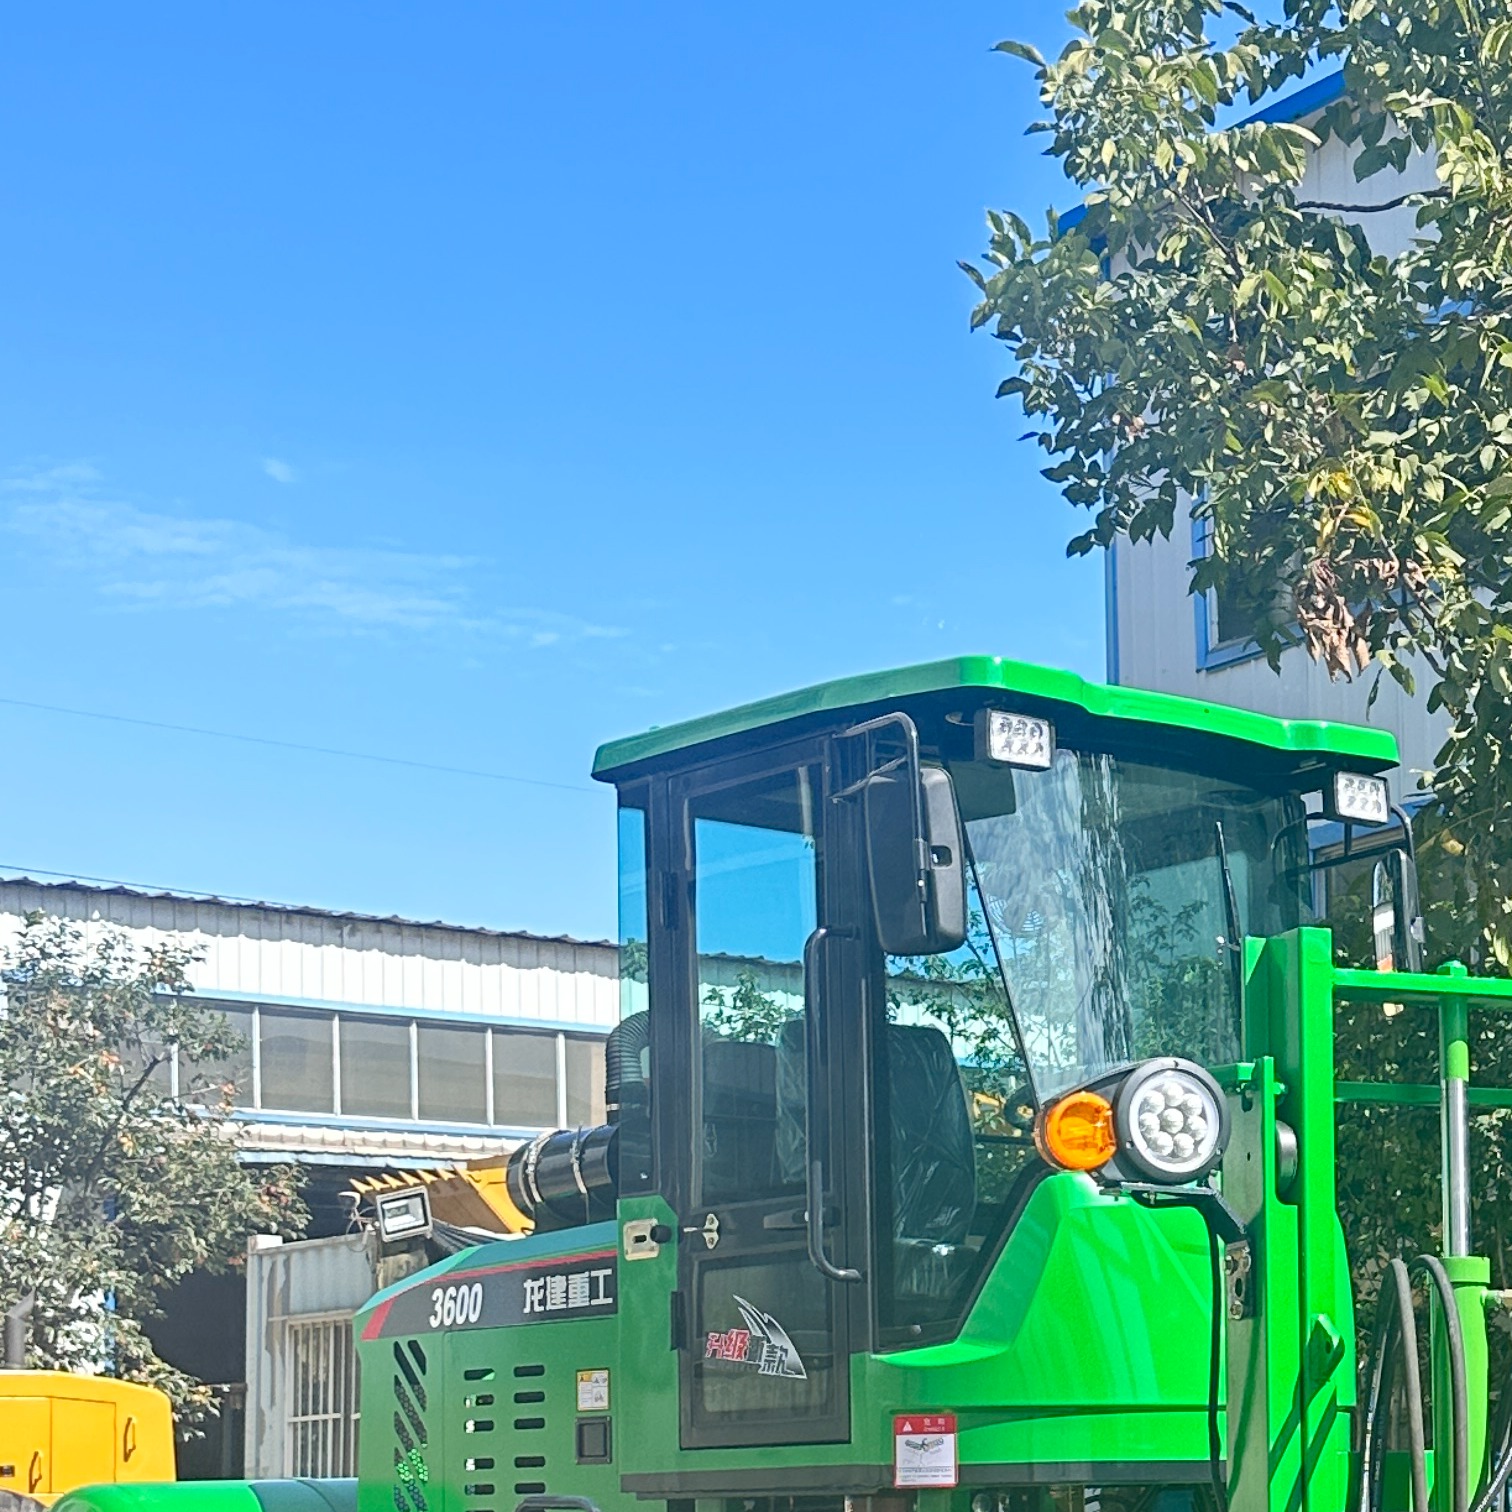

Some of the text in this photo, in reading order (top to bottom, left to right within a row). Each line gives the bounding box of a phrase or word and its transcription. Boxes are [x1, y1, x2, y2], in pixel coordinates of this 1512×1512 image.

[428, 1282, 484, 1329] 3600
[522, 1268, 614, 1314] 龙建重工
